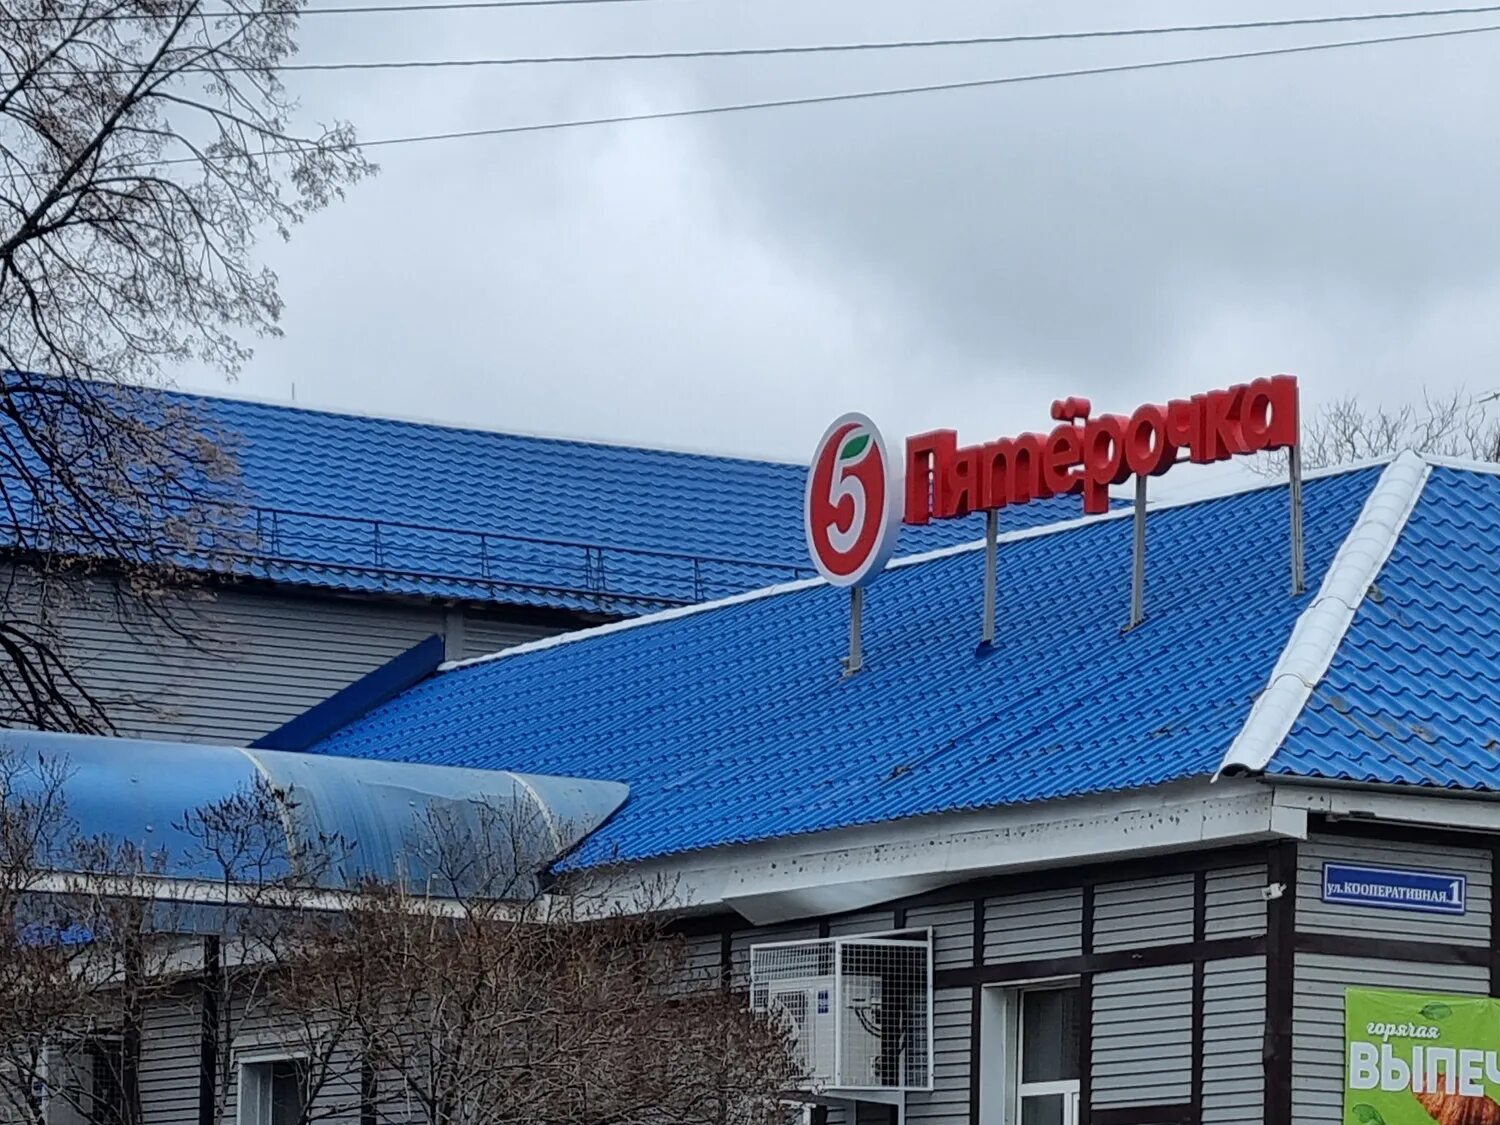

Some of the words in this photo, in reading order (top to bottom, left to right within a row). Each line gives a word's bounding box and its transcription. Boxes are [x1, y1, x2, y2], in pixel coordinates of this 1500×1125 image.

[903, 374, 1299, 525] Пятёрочка
[1449, 880, 1462, 905] 1
[1366, 1021, 1441, 1042] горячая
